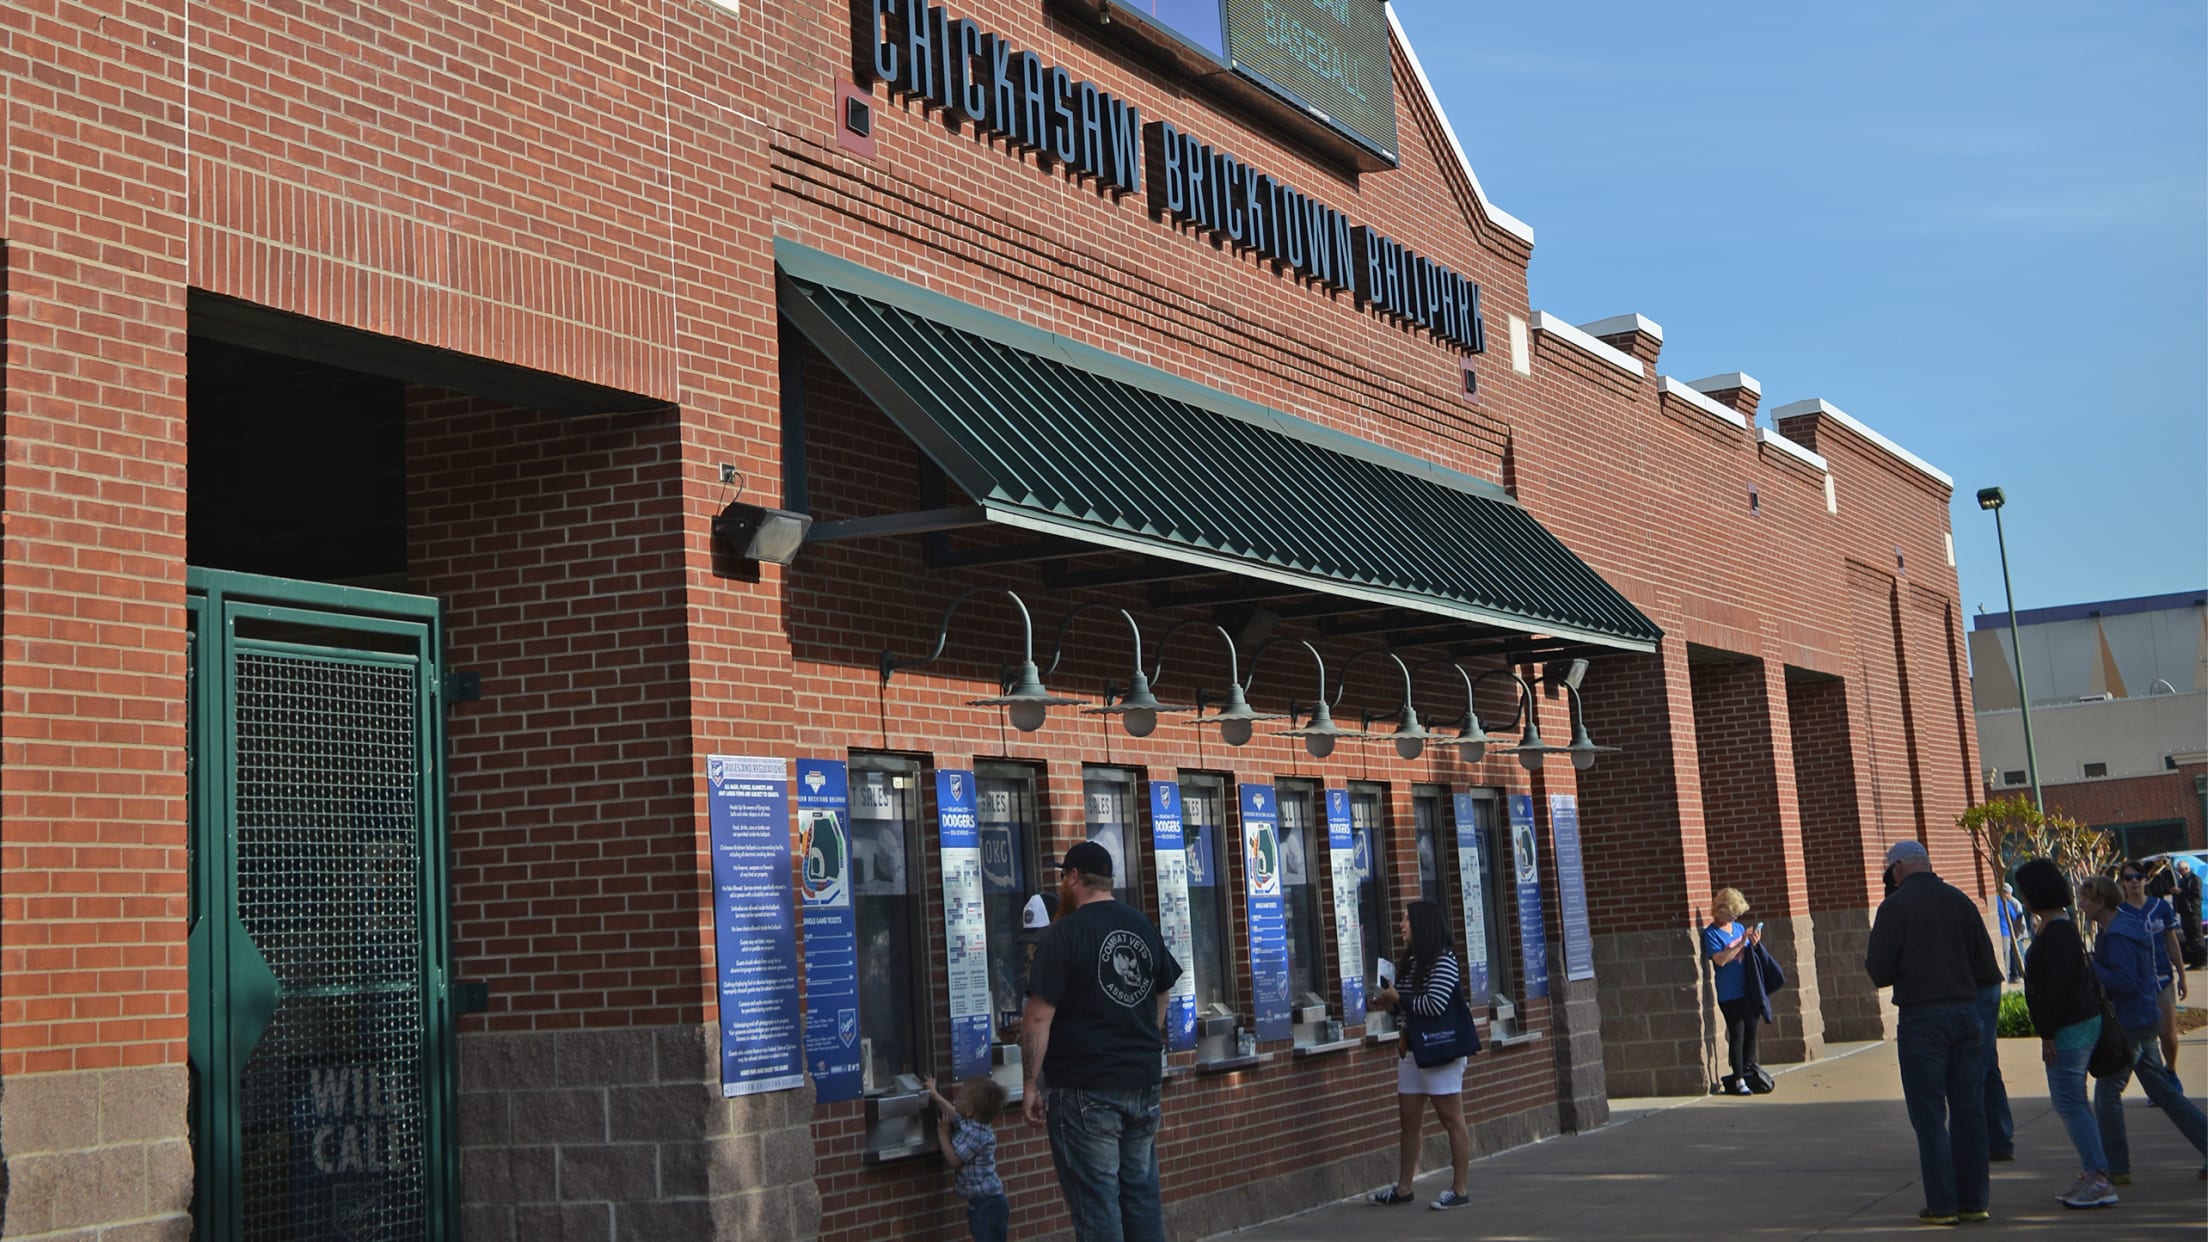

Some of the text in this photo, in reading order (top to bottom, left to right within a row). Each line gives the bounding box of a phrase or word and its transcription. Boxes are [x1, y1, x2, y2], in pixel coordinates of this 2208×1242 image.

[1263, 2, 1367, 102] BASEBALL
[873, 0, 1487, 353] CHICKASAW BRICKTOWN BALLPARK
[861, 786, 889, 808] SALES
[981, 793, 1007, 813] SALES
[1087, 796, 1110, 815] SALES
[942, 814, 976, 829] DODGERS
[1155, 820, 1181, 833] DODGERS
[1329, 823, 1351, 835] DODGERS
[984, 840, 1009, 864] OKC
[310, 1067, 407, 1118] WILL
[312, 1123, 408, 1175] CALL
